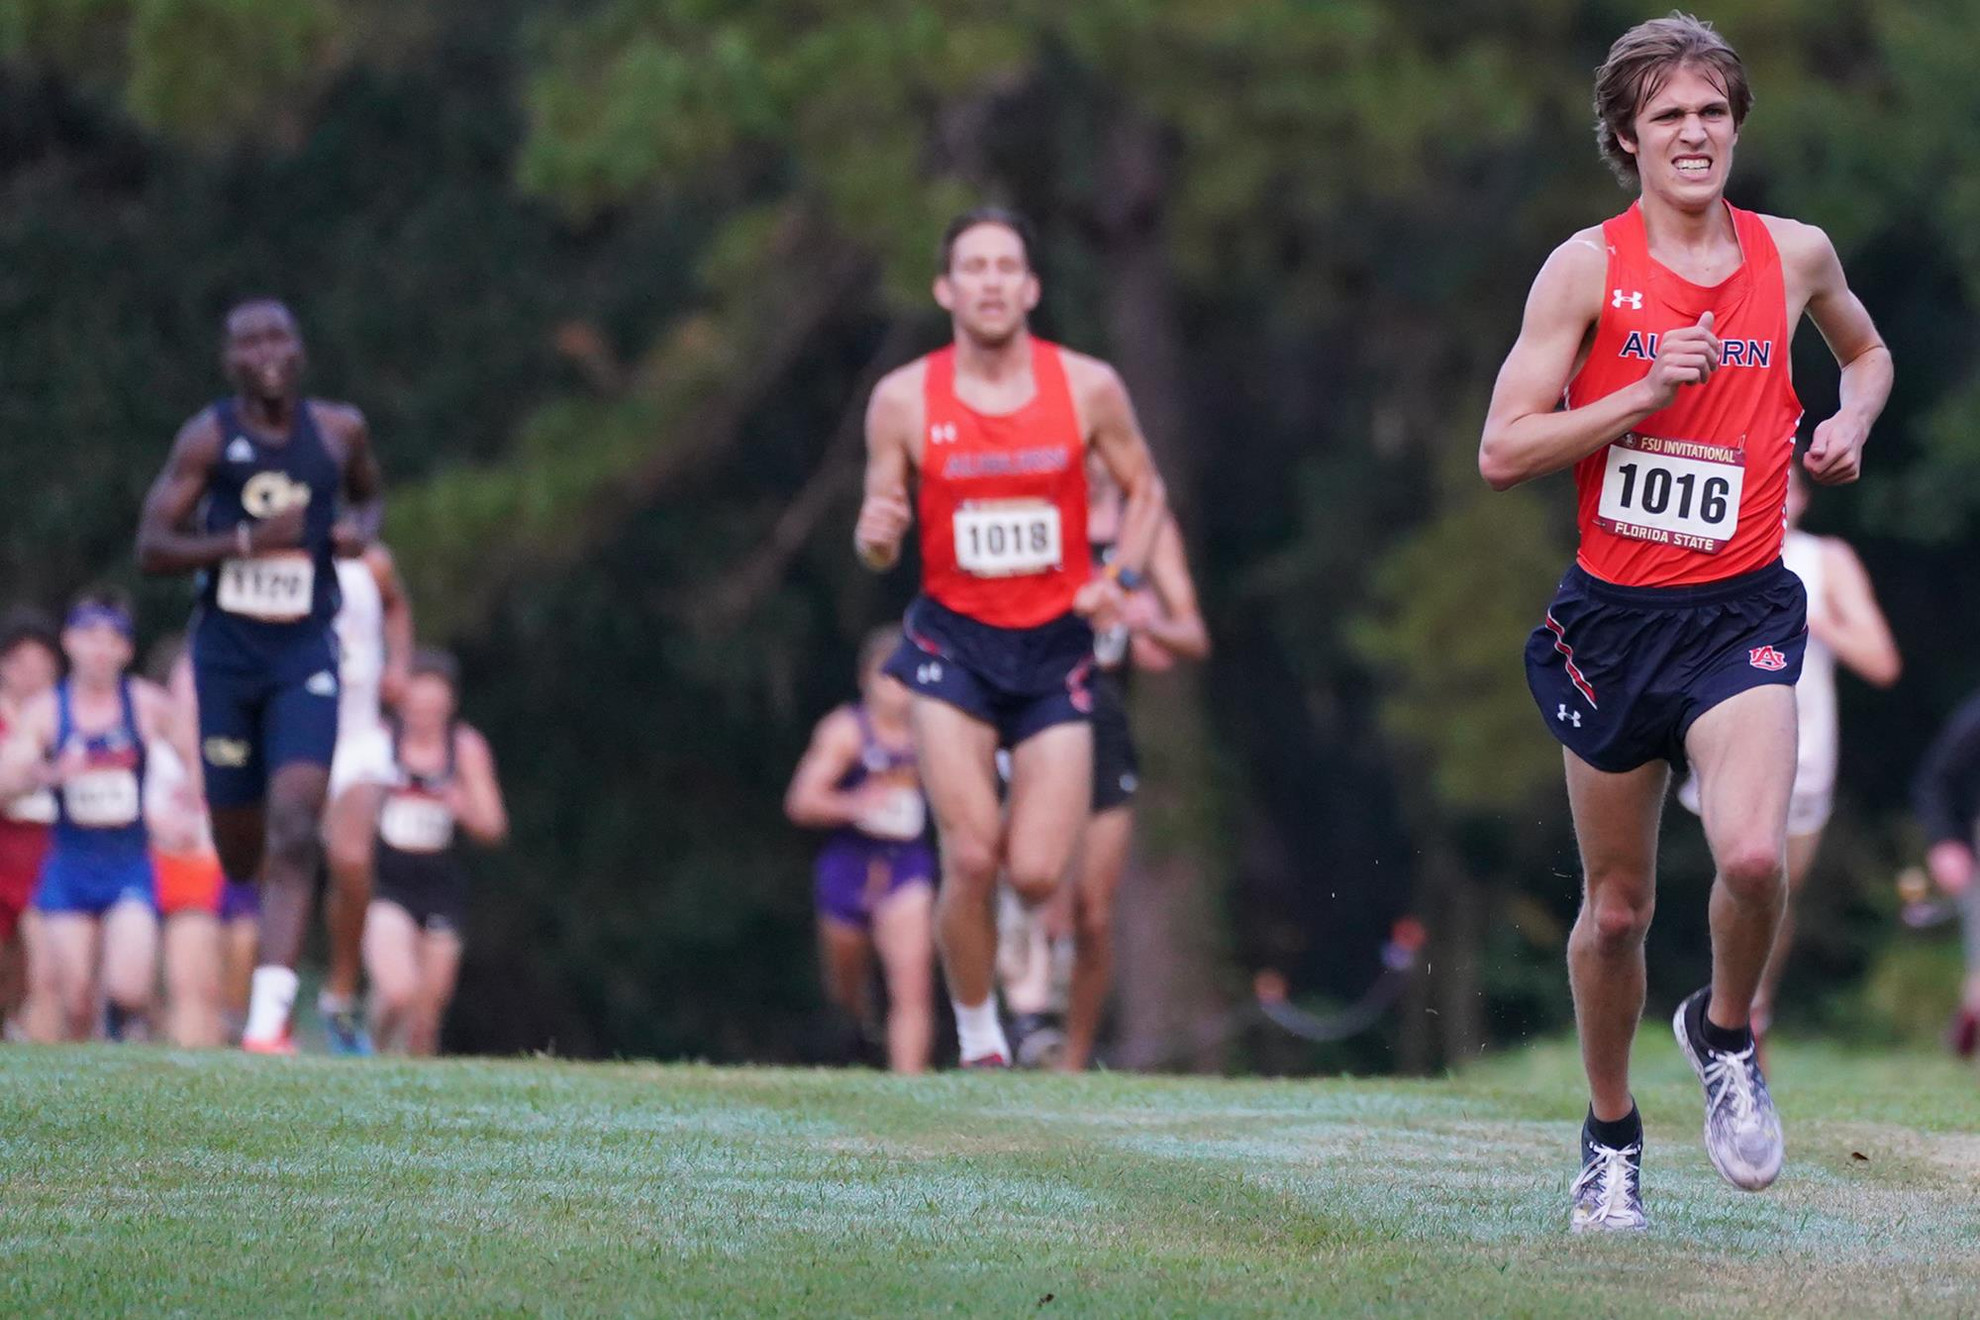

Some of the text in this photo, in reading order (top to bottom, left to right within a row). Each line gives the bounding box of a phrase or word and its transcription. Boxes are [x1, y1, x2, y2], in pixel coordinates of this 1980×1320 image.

[1641, 437, 1735, 463] FSU INVITATIONAL
[1619, 463, 1729, 525] 1016
[967, 521, 1048, 557] 1018
[1615, 522, 1714, 550] FLORIDA STATE
